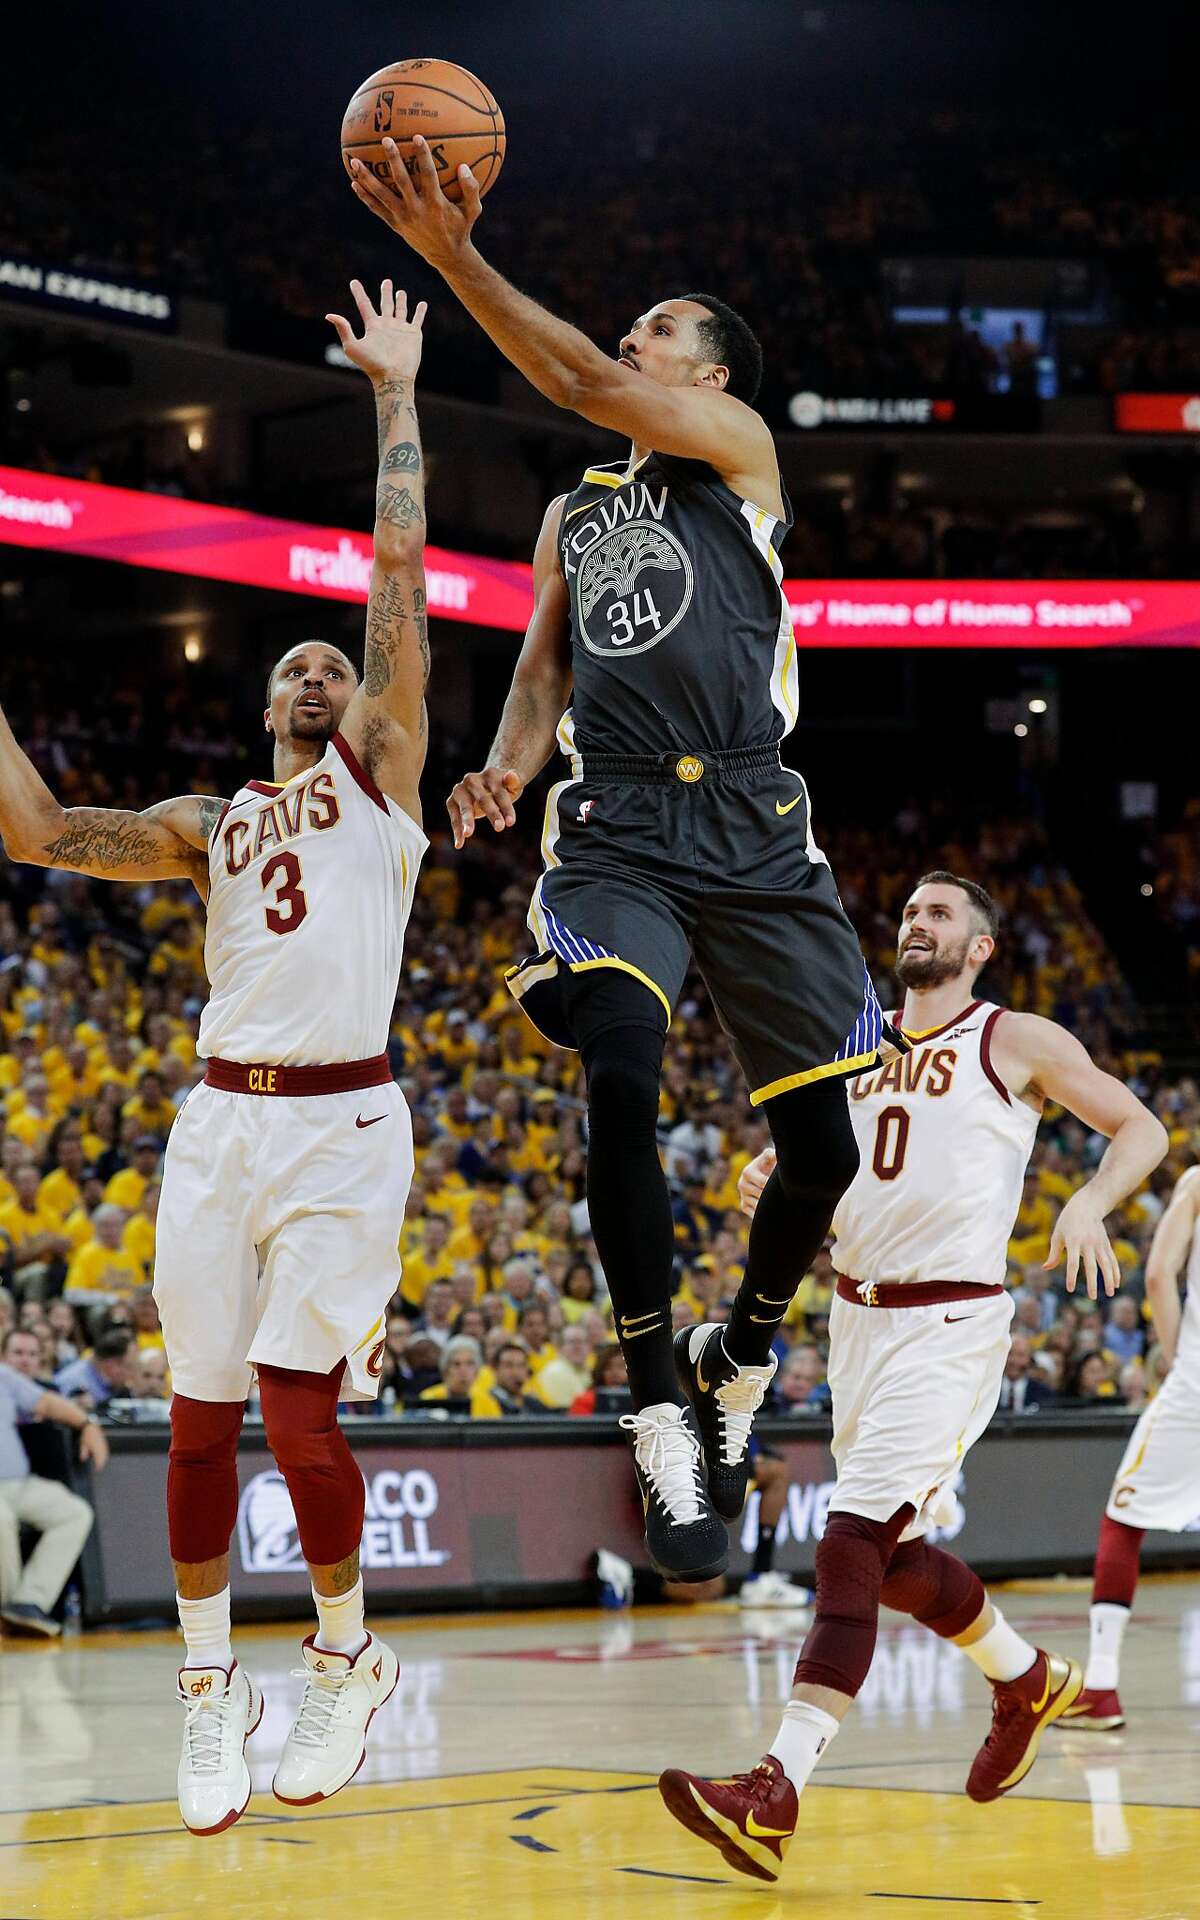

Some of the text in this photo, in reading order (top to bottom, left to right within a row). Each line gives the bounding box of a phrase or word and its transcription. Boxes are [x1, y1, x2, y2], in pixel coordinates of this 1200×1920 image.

[45, 270, 171, 320] EXPRESS
[564, 482, 669, 580] TOWN
[605, 587, 662, 647] 34
[827, 599, 911, 627] Home
[913, 598, 947, 627] of
[949, 599, 1033, 627] Home
[1035, 599, 1132, 627] Search
[223, 772, 341, 878] CAVS
[260, 850, 309, 936] 3
[248, 1068, 277, 1092] CLE
[872, 1105, 910, 1181] 0
[362, 1518, 443, 1569] ELL
